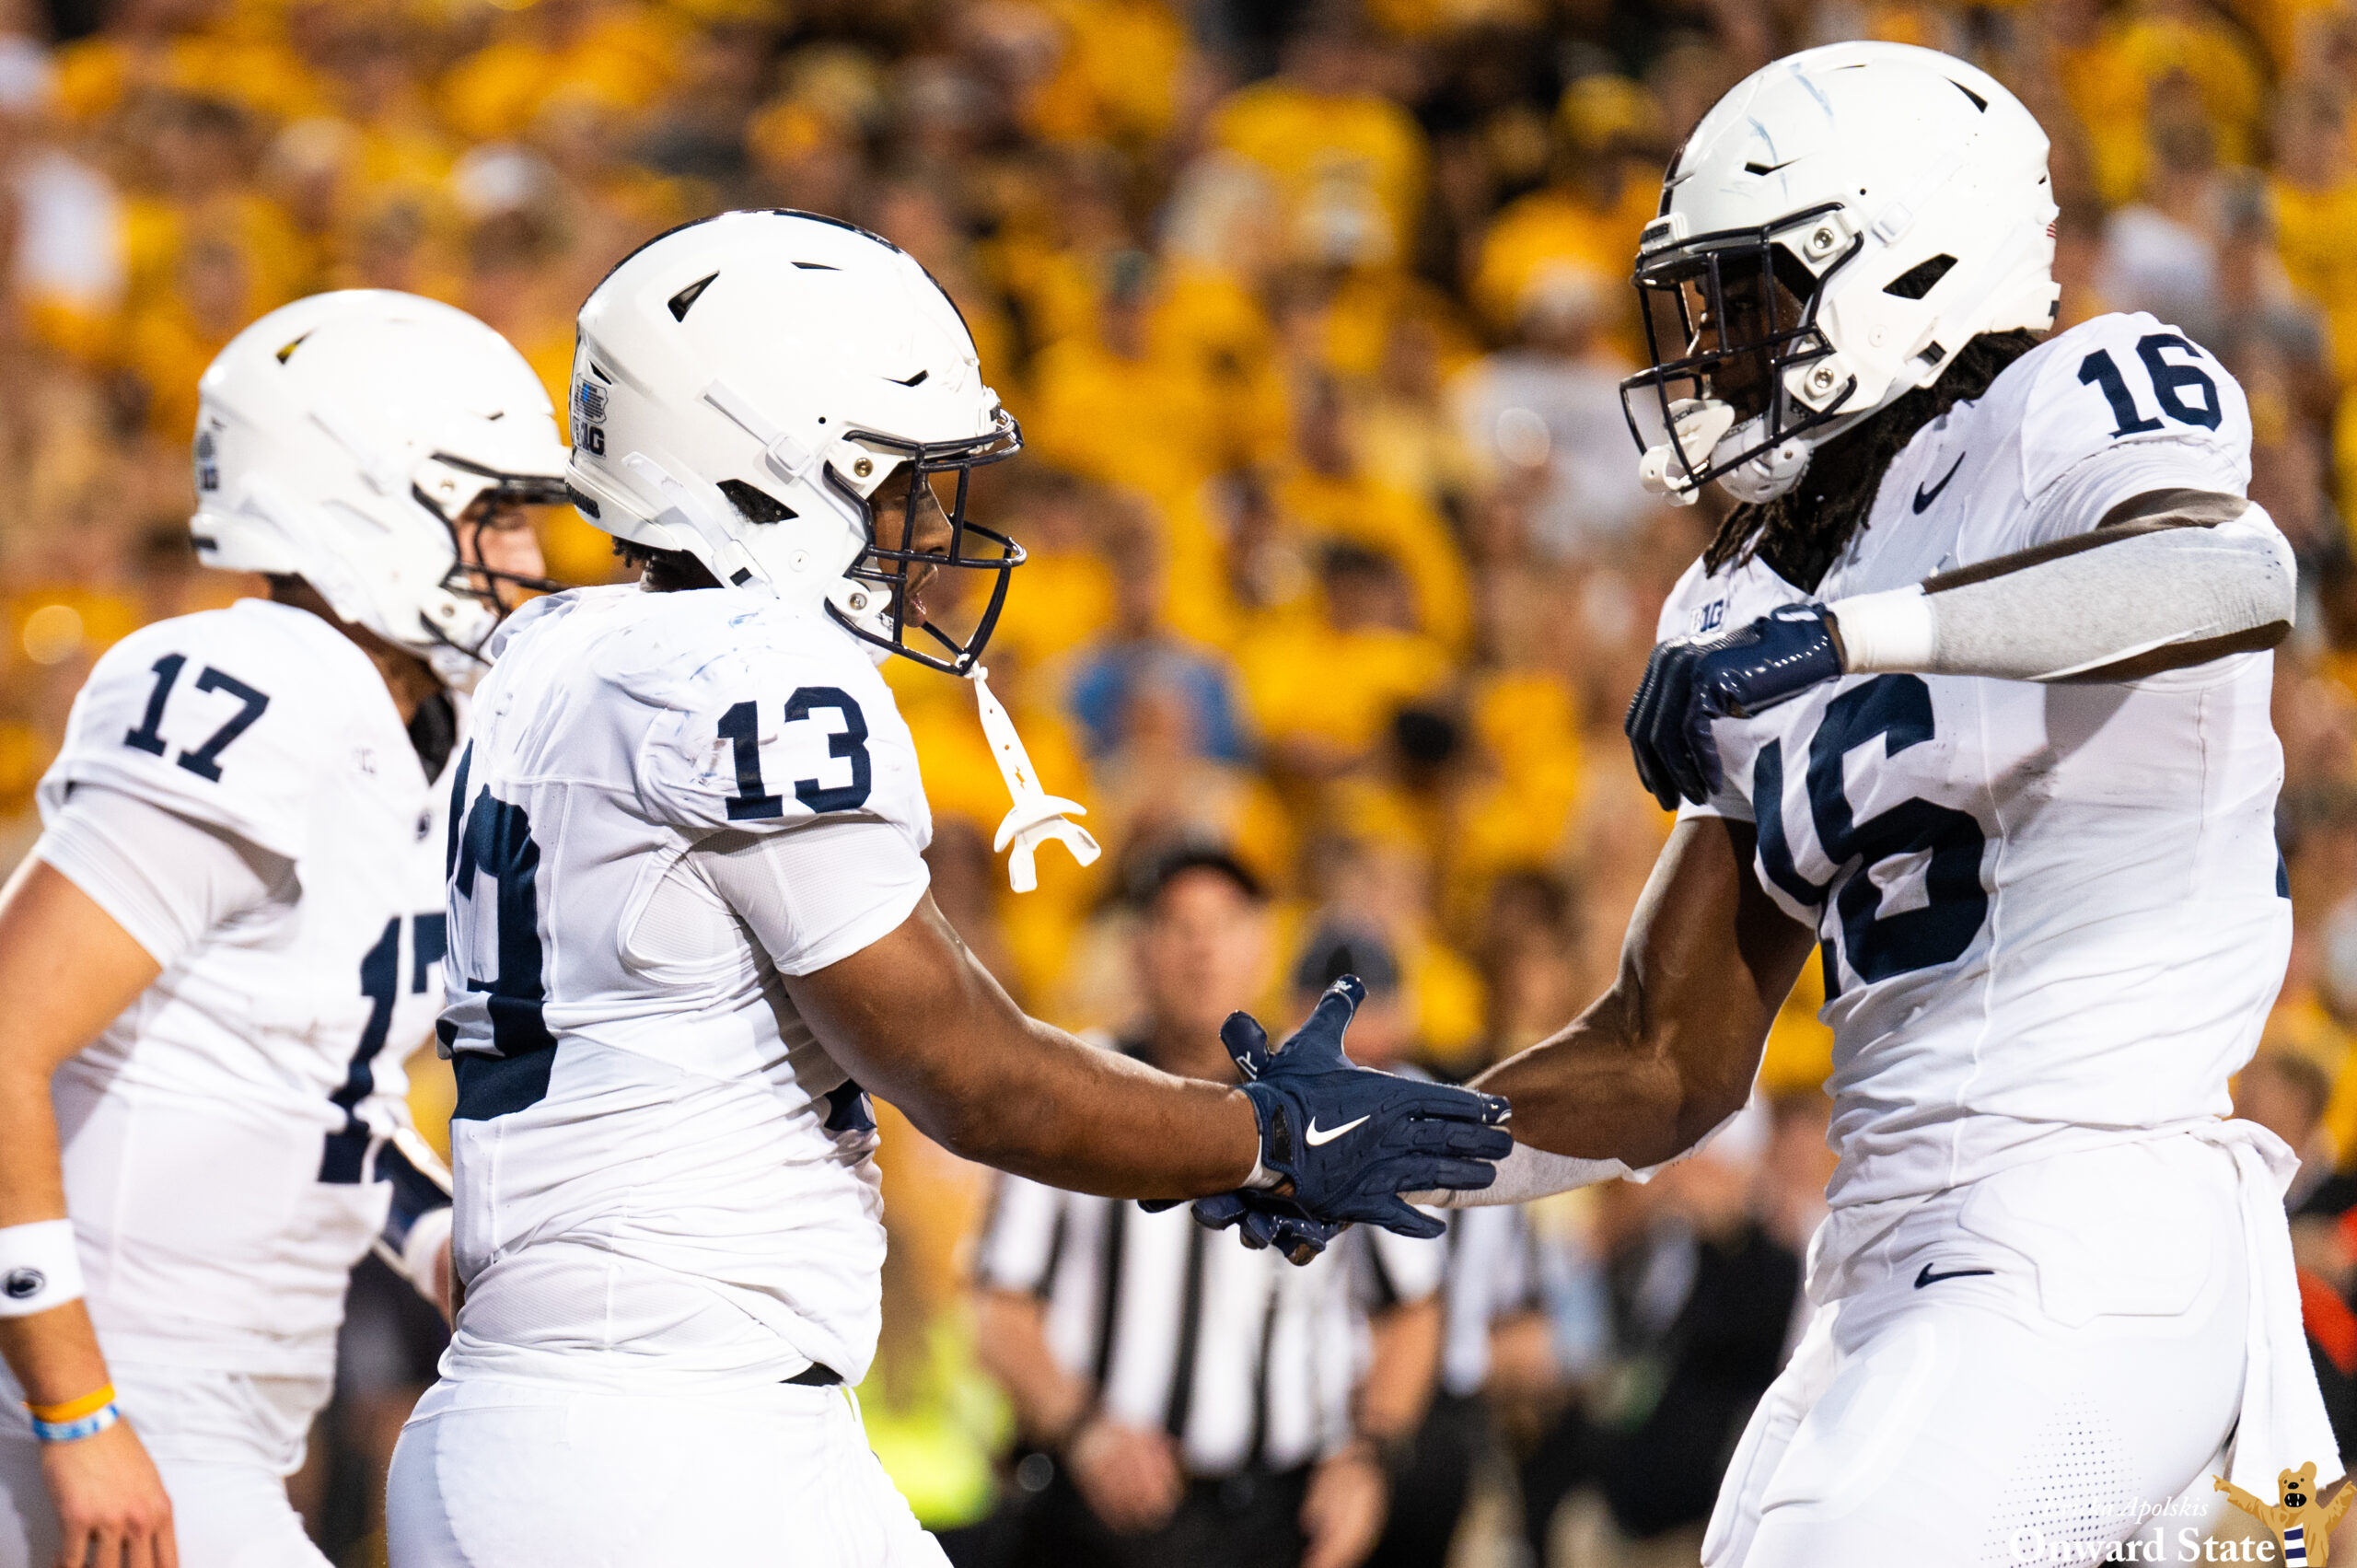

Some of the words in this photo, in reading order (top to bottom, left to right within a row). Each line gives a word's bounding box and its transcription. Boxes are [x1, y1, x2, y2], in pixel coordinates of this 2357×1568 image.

[2076, 332, 2223, 440] 16
[122, 653, 270, 784] 17
[717, 686, 872, 820] 13
